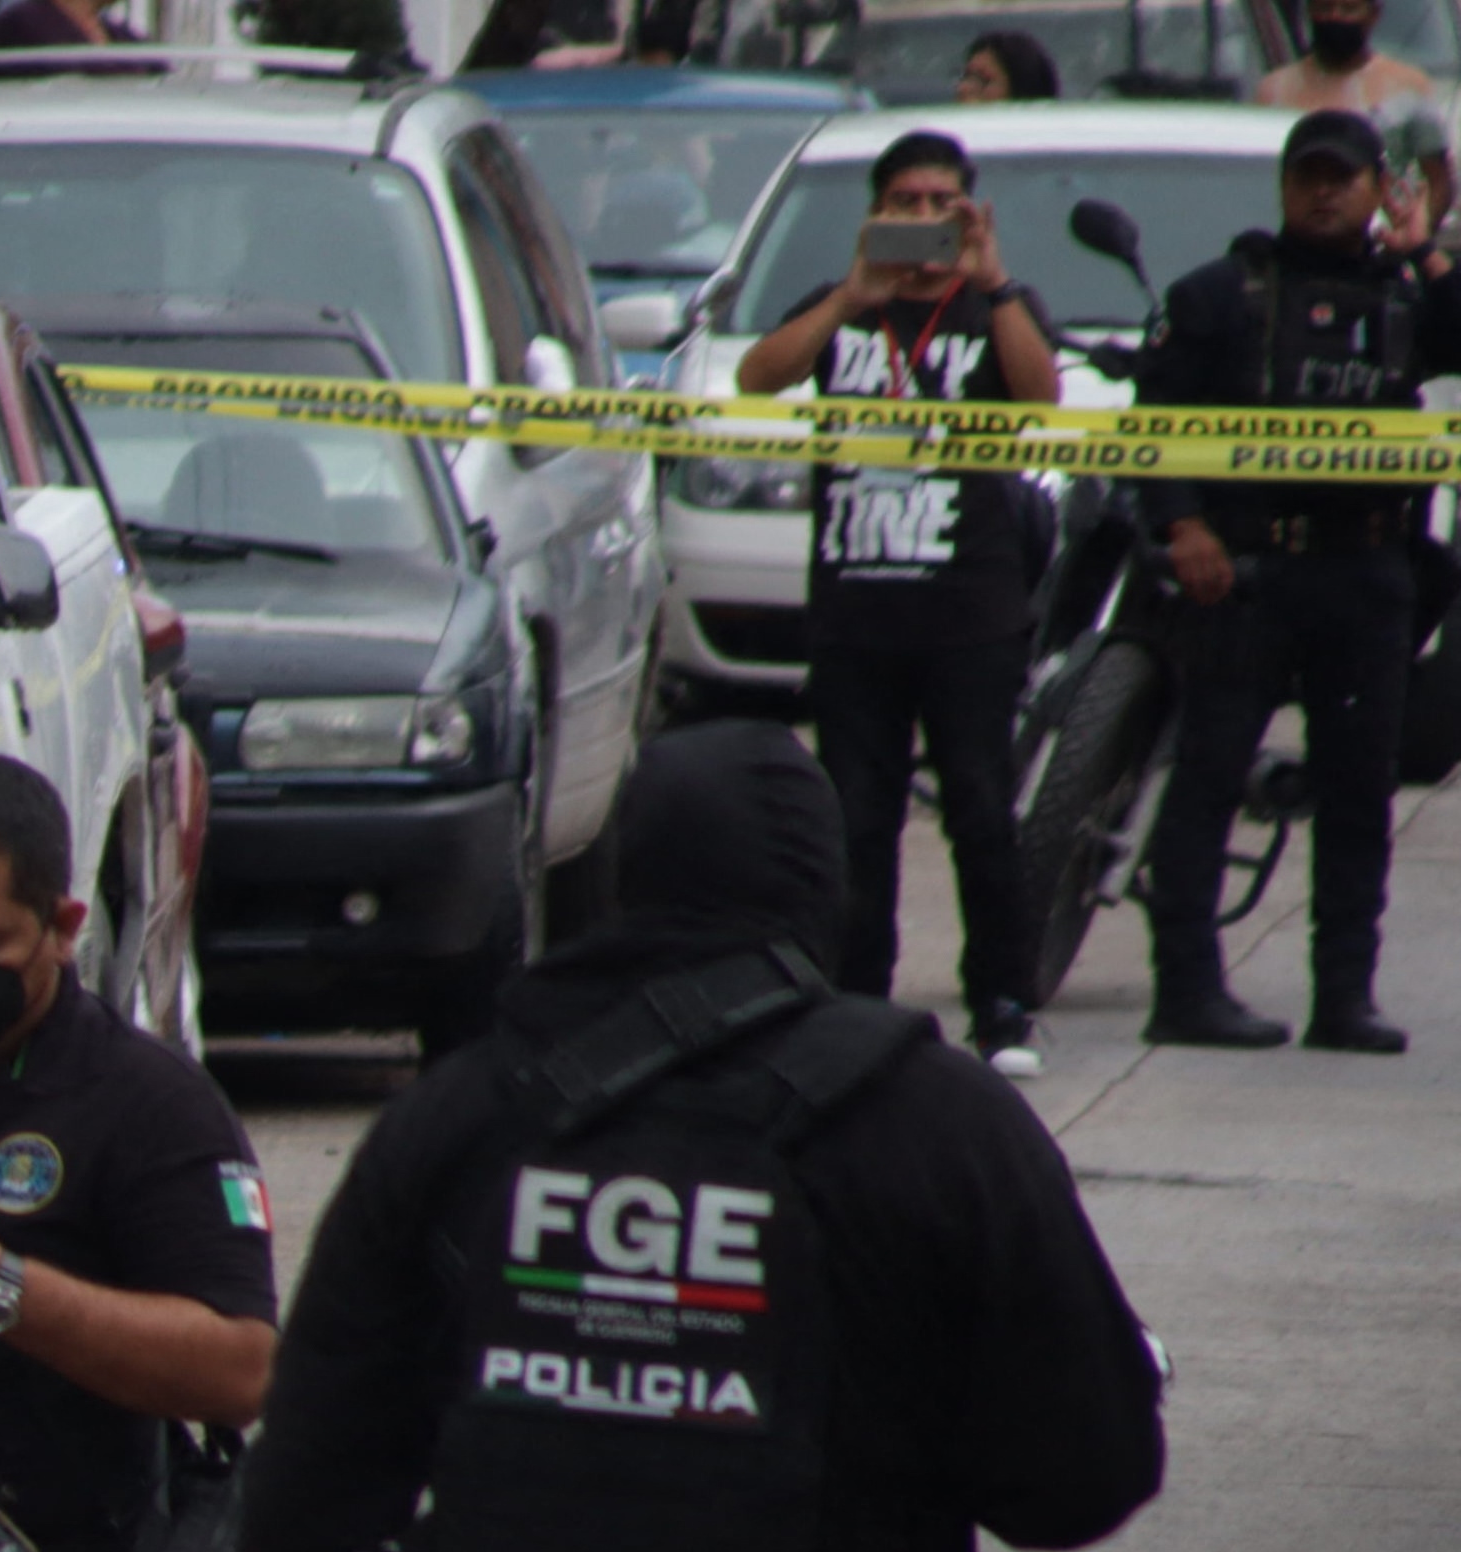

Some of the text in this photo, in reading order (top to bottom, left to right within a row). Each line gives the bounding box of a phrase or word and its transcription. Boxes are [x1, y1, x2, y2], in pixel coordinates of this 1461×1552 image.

[1117, 415, 1375, 437] PROHIBIDO
[907, 440, 1162, 469] PROHIBIDO
[1229, 443, 1461, 473] PROHIBID
[508, 1165, 774, 1286] FGE
[482, 1348, 759, 1416] POLICIA
